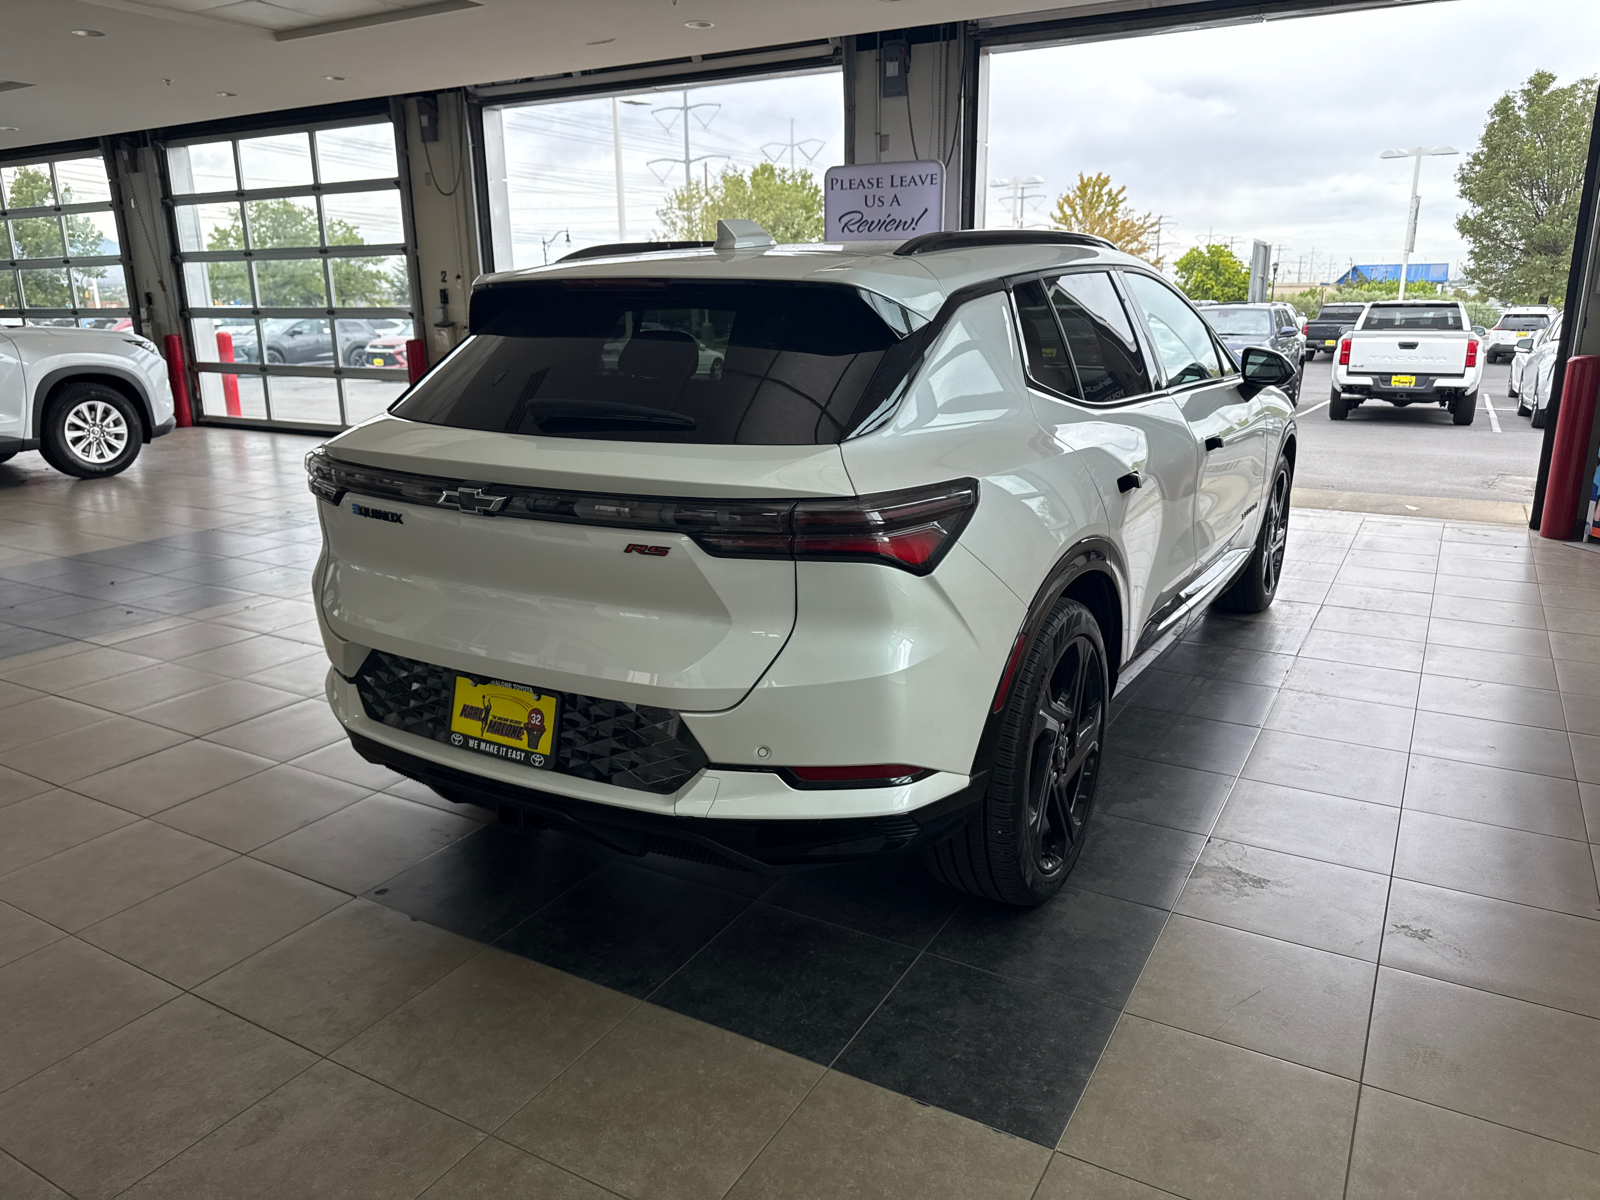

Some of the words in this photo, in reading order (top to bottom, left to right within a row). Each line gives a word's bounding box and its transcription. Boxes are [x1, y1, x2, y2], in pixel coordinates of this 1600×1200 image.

[830, 177, 884, 191] PLEASE
[890, 173, 938, 188] LEAVE
[889, 193, 902, 207] A
[838, 207, 928, 234] Review!
[440, 270, 448, 283] 2
[1368, 355, 1447, 363] TACOMA
[623, 543, 672, 557] RS
[513, 684, 534, 693] TOYOTA
[459, 703, 485, 722] KARL
[530, 713, 542, 726] 32
[486, 719, 525, 741] MALONE
[468, 738, 479, 749] WE
[480, 741, 498, 755] MAKE
[500, 746, 507, 757] IT
[508, 748, 526, 761] EASY
